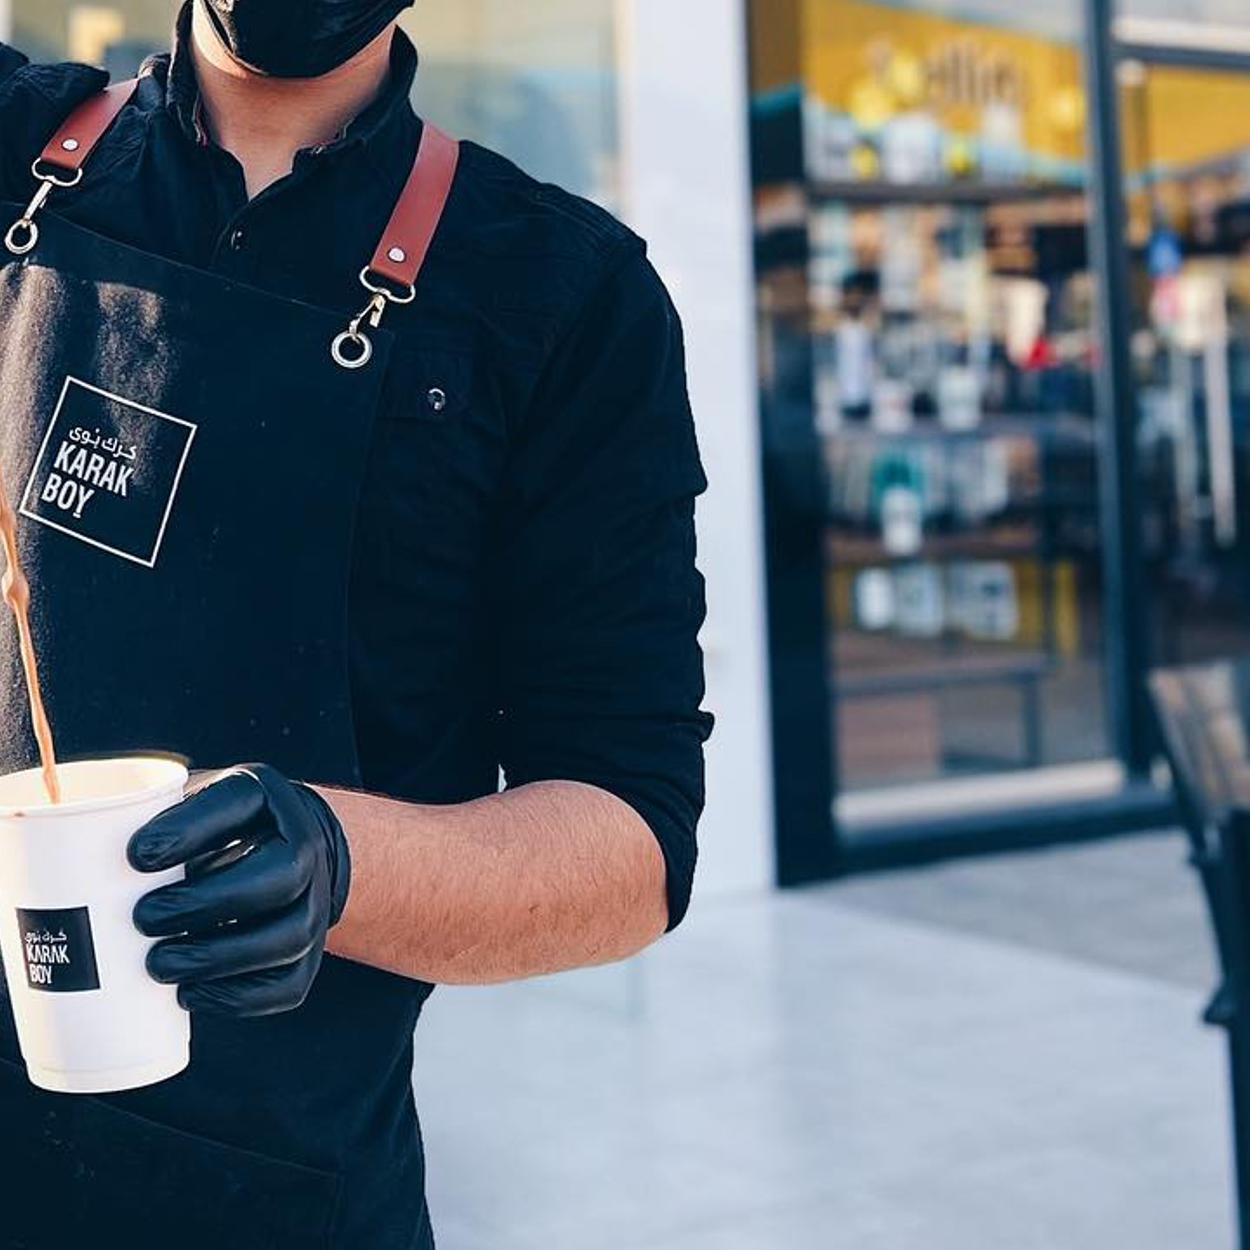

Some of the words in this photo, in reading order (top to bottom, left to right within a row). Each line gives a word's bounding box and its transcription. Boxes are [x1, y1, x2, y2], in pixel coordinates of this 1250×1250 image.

[53, 440, 135, 497] KARAK
[41, 472, 95, 519] BOY
[26, 944, 71, 964] KARAK
[29, 963, 53, 985] BOY
